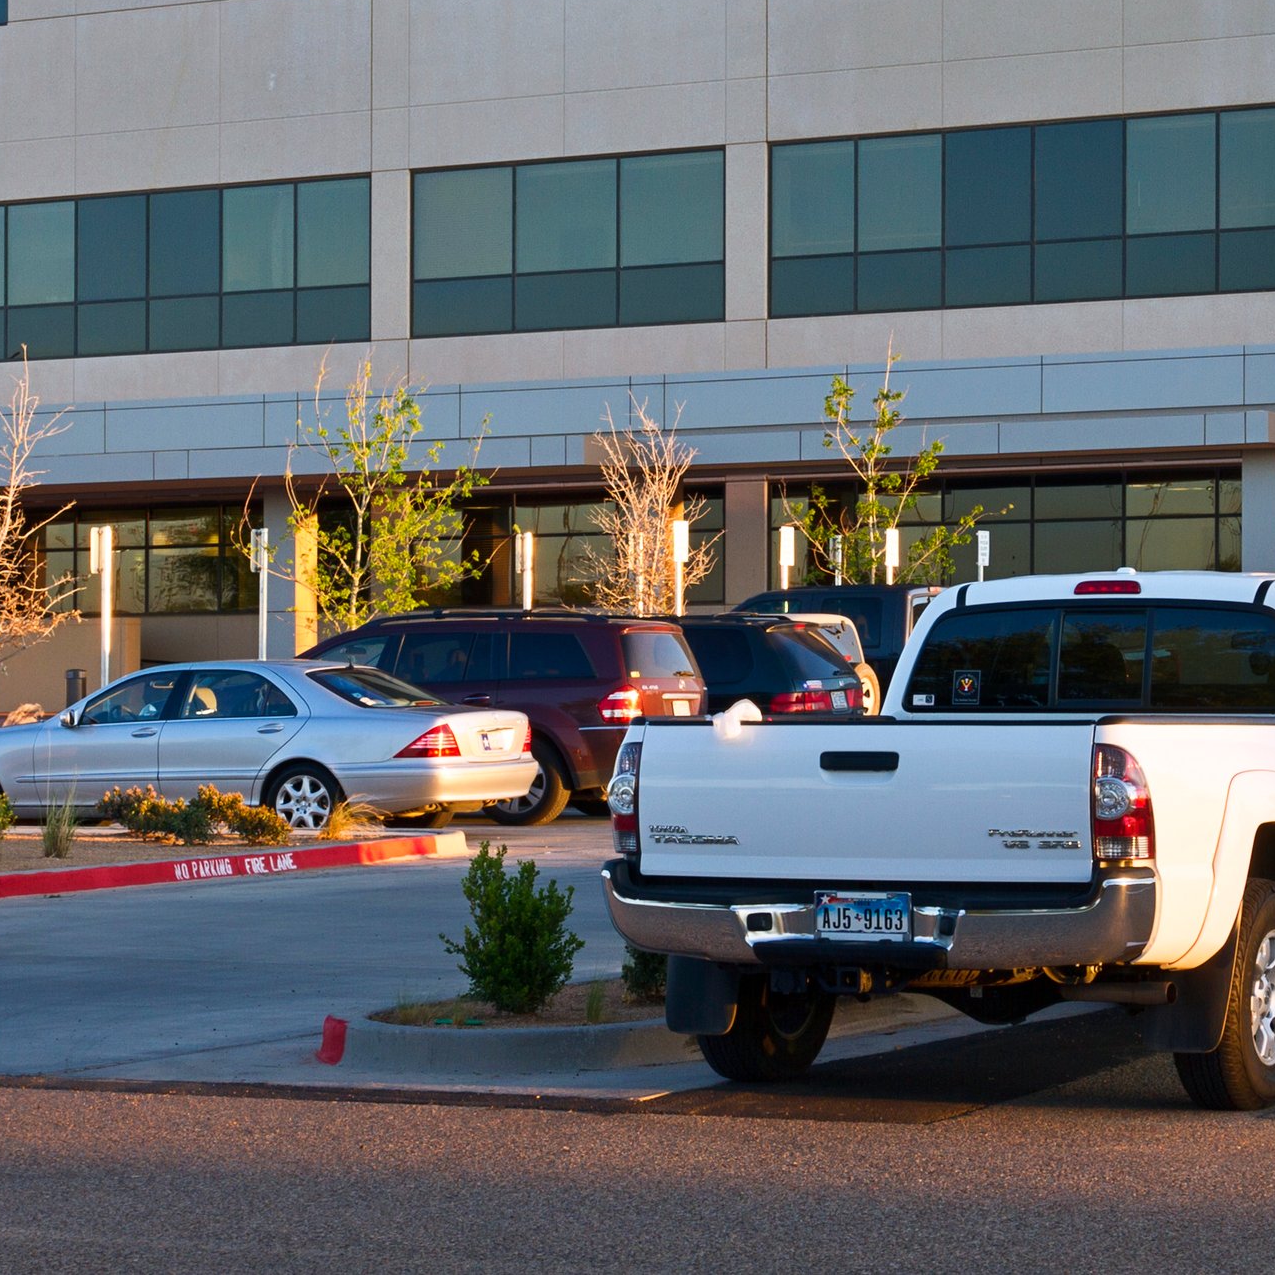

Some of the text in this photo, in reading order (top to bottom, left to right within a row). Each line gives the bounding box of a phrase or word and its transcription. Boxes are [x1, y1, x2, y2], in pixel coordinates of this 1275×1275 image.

[649, 834, 741, 845] TACOMA
[173, 853, 297, 880] NO PARKING FIRE LANE
